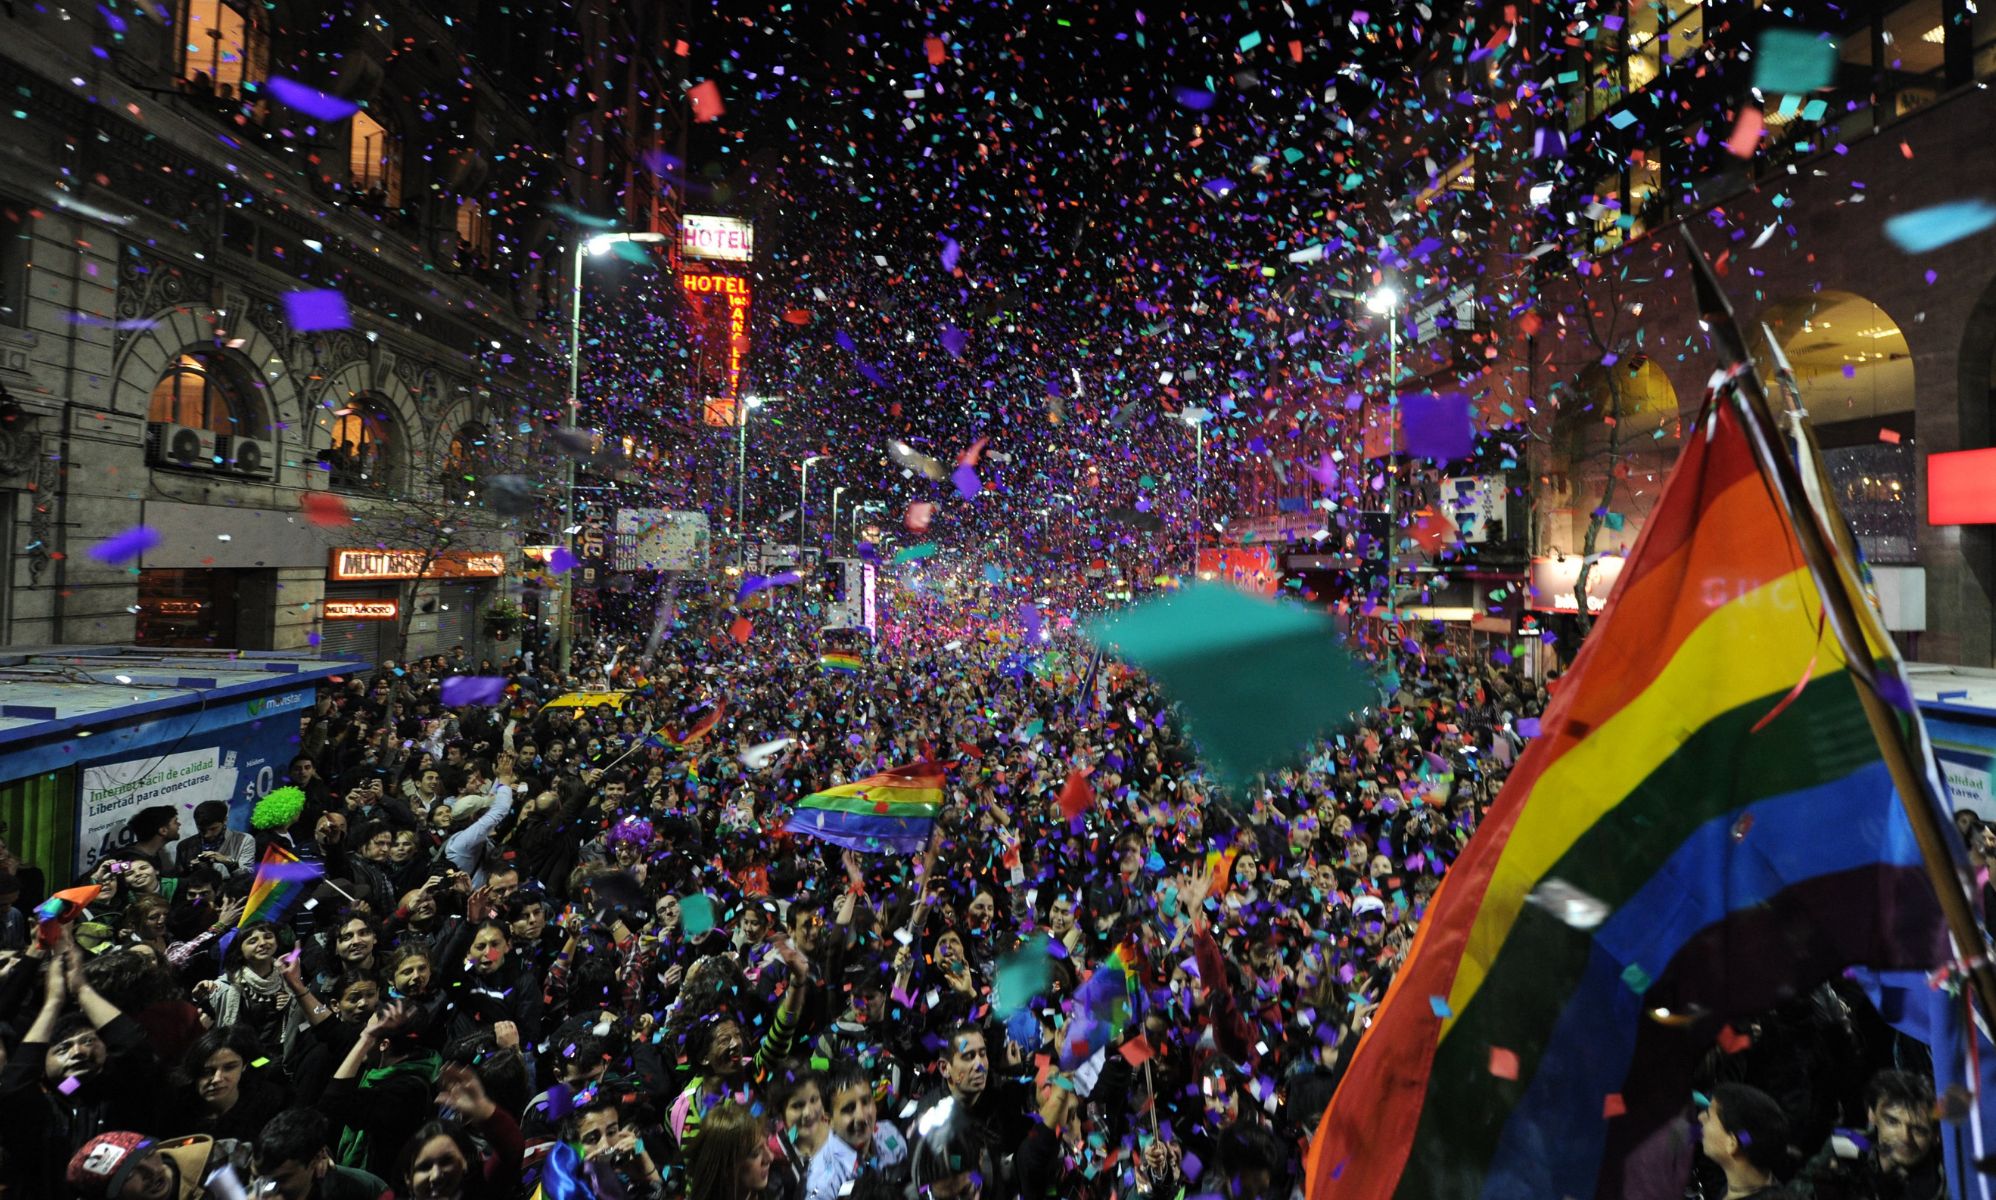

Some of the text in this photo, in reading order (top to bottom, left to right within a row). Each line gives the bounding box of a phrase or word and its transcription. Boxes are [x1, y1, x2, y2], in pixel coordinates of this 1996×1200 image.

[684, 228, 749, 249] HOTEL
[683, 274, 746, 294] HOTEL
[344, 553, 383, 574] MULTI
[326, 605, 391, 614] MULTI AHORRO
[90, 781, 137, 802] Internet
[166, 769, 178, 781] de
[180, 758, 213, 777] calidad
[1948, 774, 1984, 790] alidad
[88, 774, 212, 817] Libertad para conectarse.
[1951, 787, 1983, 801] tarse.
